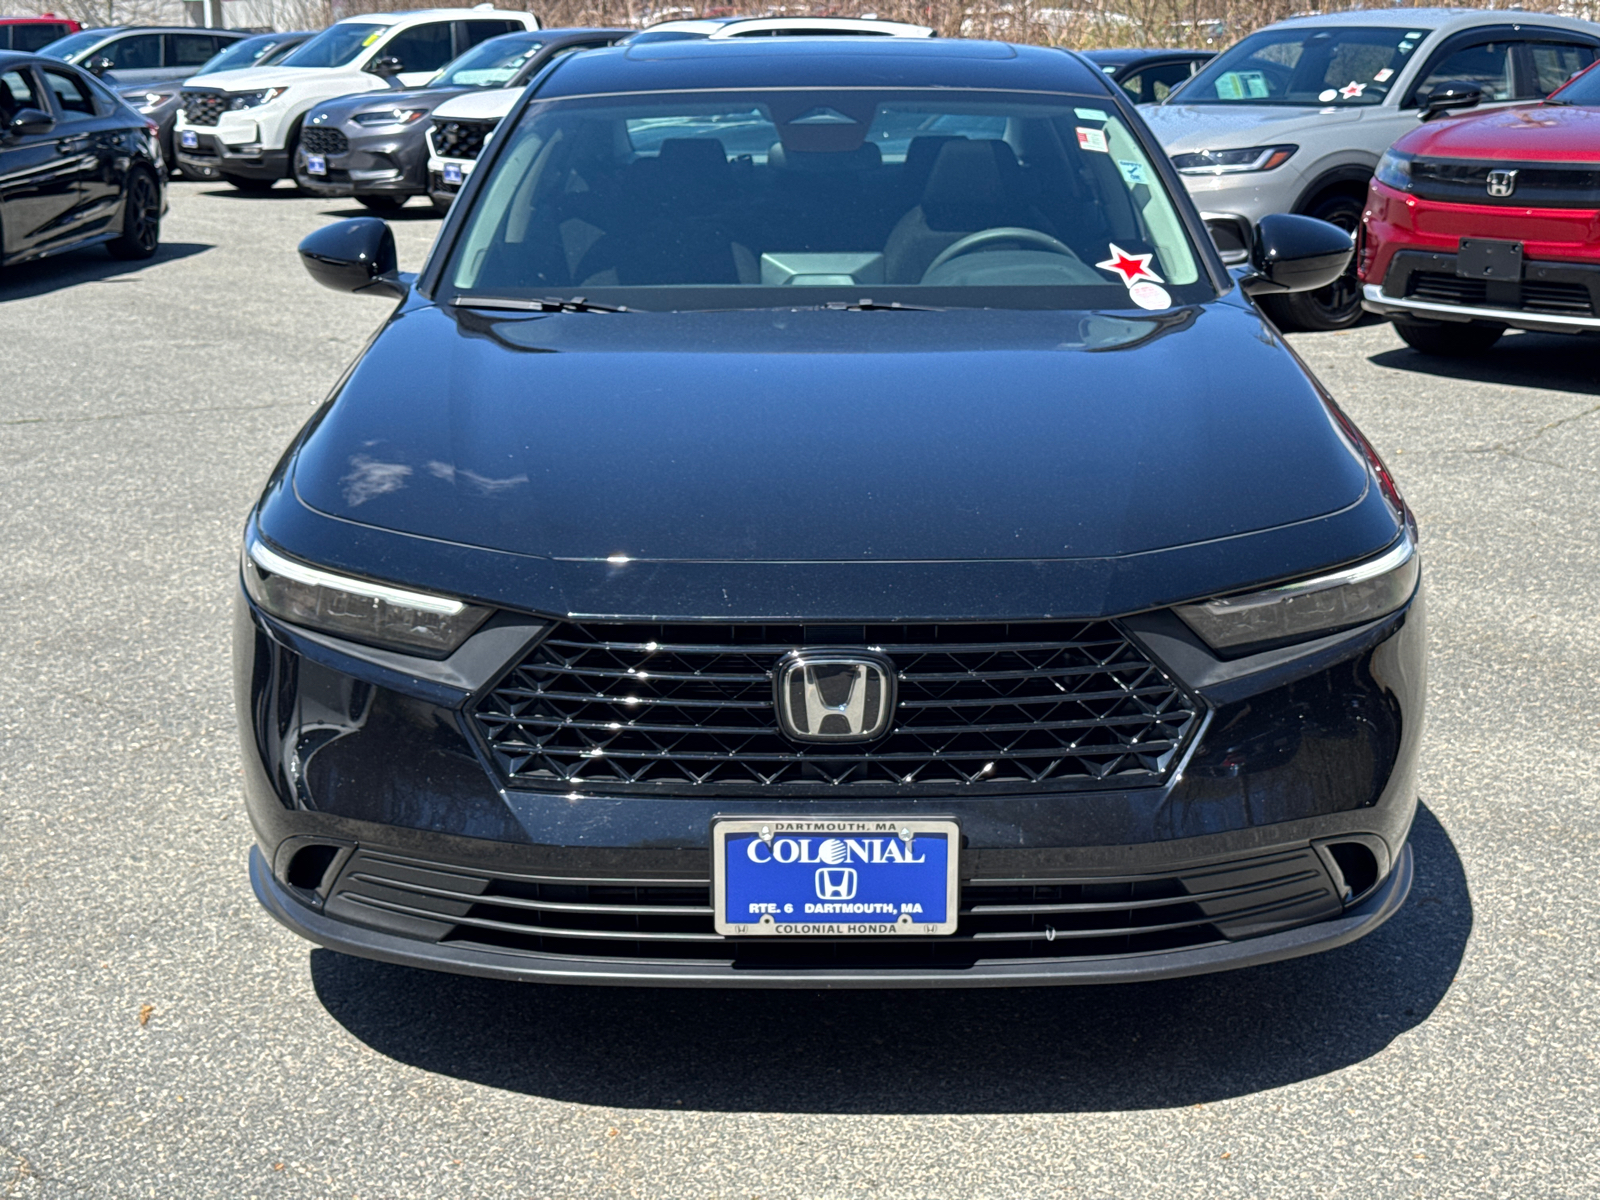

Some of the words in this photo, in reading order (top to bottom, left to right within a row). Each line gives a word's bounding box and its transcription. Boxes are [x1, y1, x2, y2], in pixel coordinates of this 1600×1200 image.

[875, 823, 897, 831] MA
[747, 838, 926, 865] COLONIAL
[749, 902, 782, 914] RTE.
[784, 902, 794, 914] 6
[804, 902, 898, 915] DARTMOUTH,
[900, 902, 923, 914] MA
[775, 924, 843, 934] COLONIAL
[848, 924, 897, 934] HONDA
